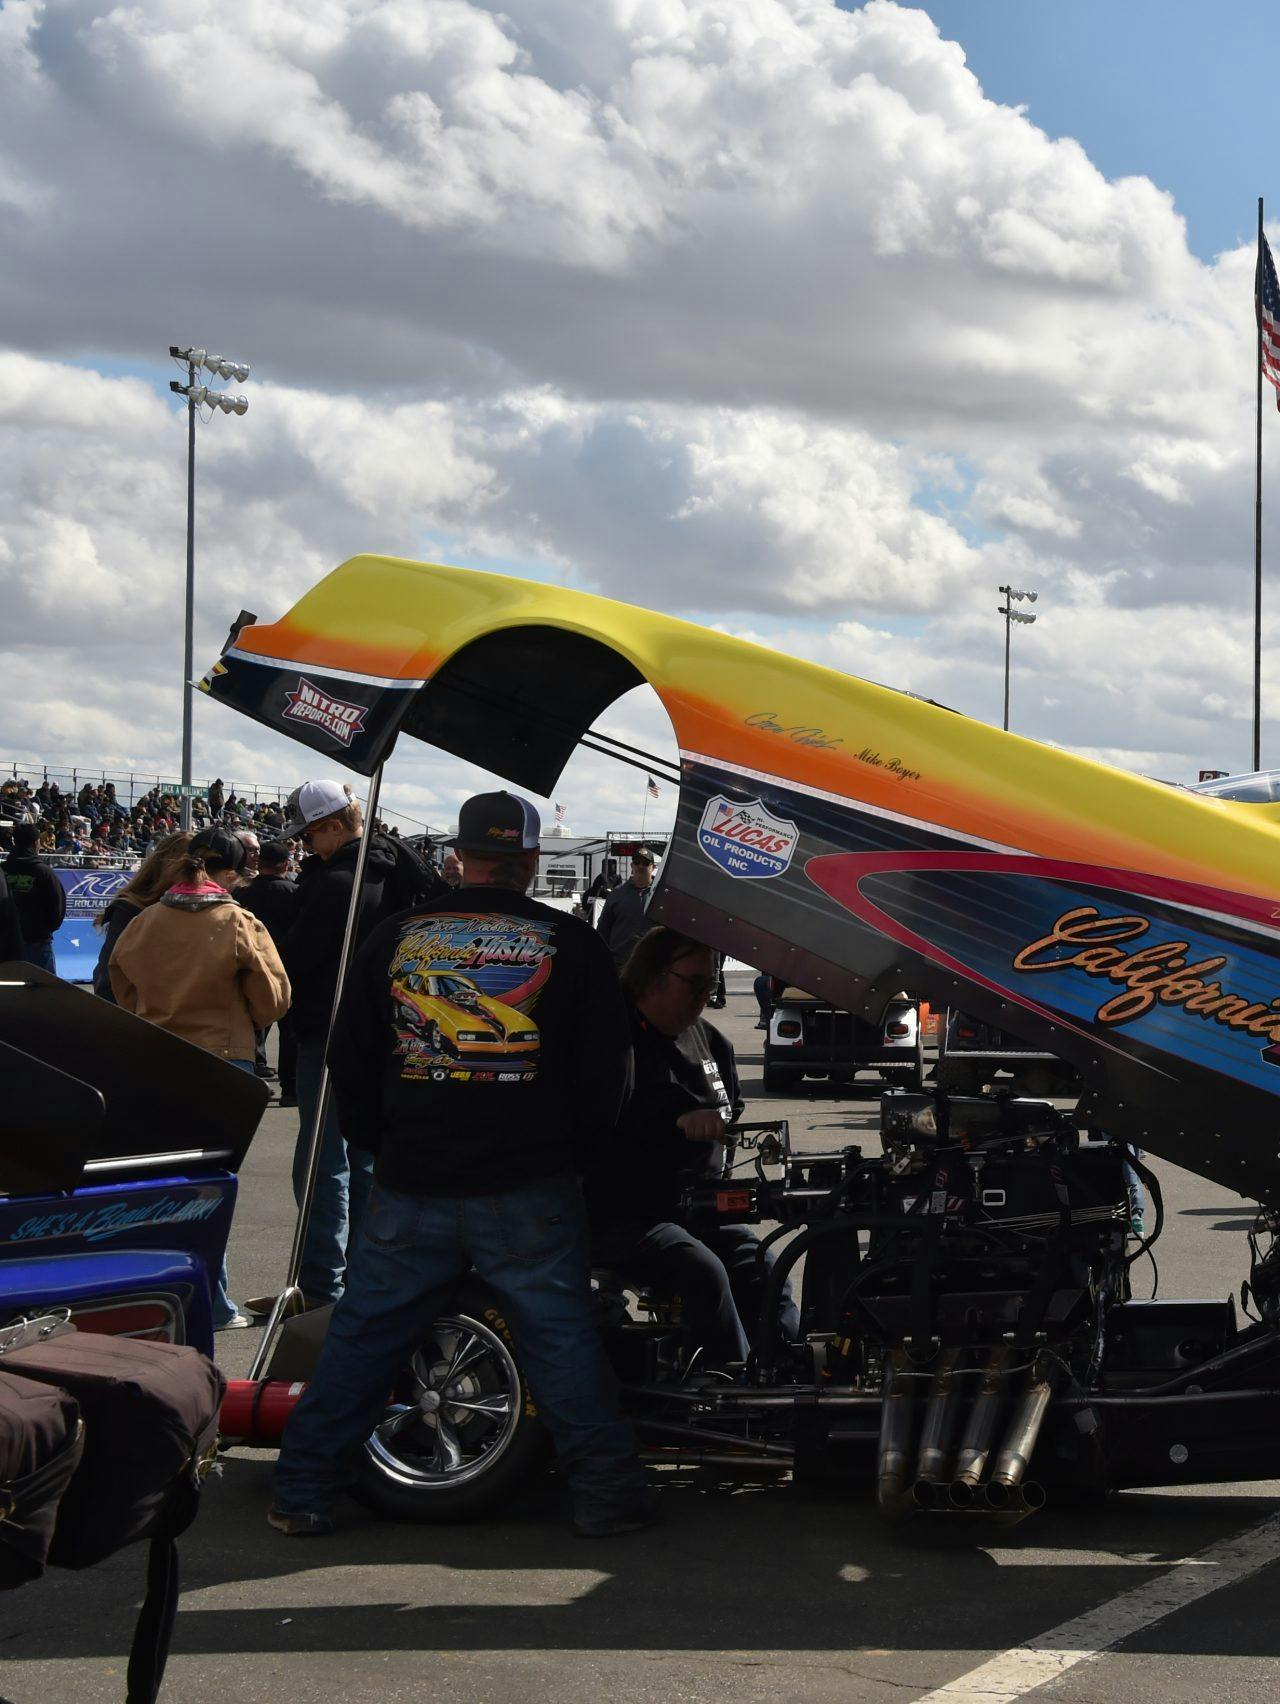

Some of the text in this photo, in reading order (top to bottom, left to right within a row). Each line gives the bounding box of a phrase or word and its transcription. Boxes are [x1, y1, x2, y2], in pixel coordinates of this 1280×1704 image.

[290, 701, 351, 740] REPORTS.COM
[300, 684, 360, 723] NITRO
[853, 747, 922, 781] Mike Boyer
[702, 834, 783, 871] OIL PRODUCTS
[711, 818, 790, 853] LUCAS
[727, 857, 750, 872] INC.
[453, 936, 558, 970] Hustler
